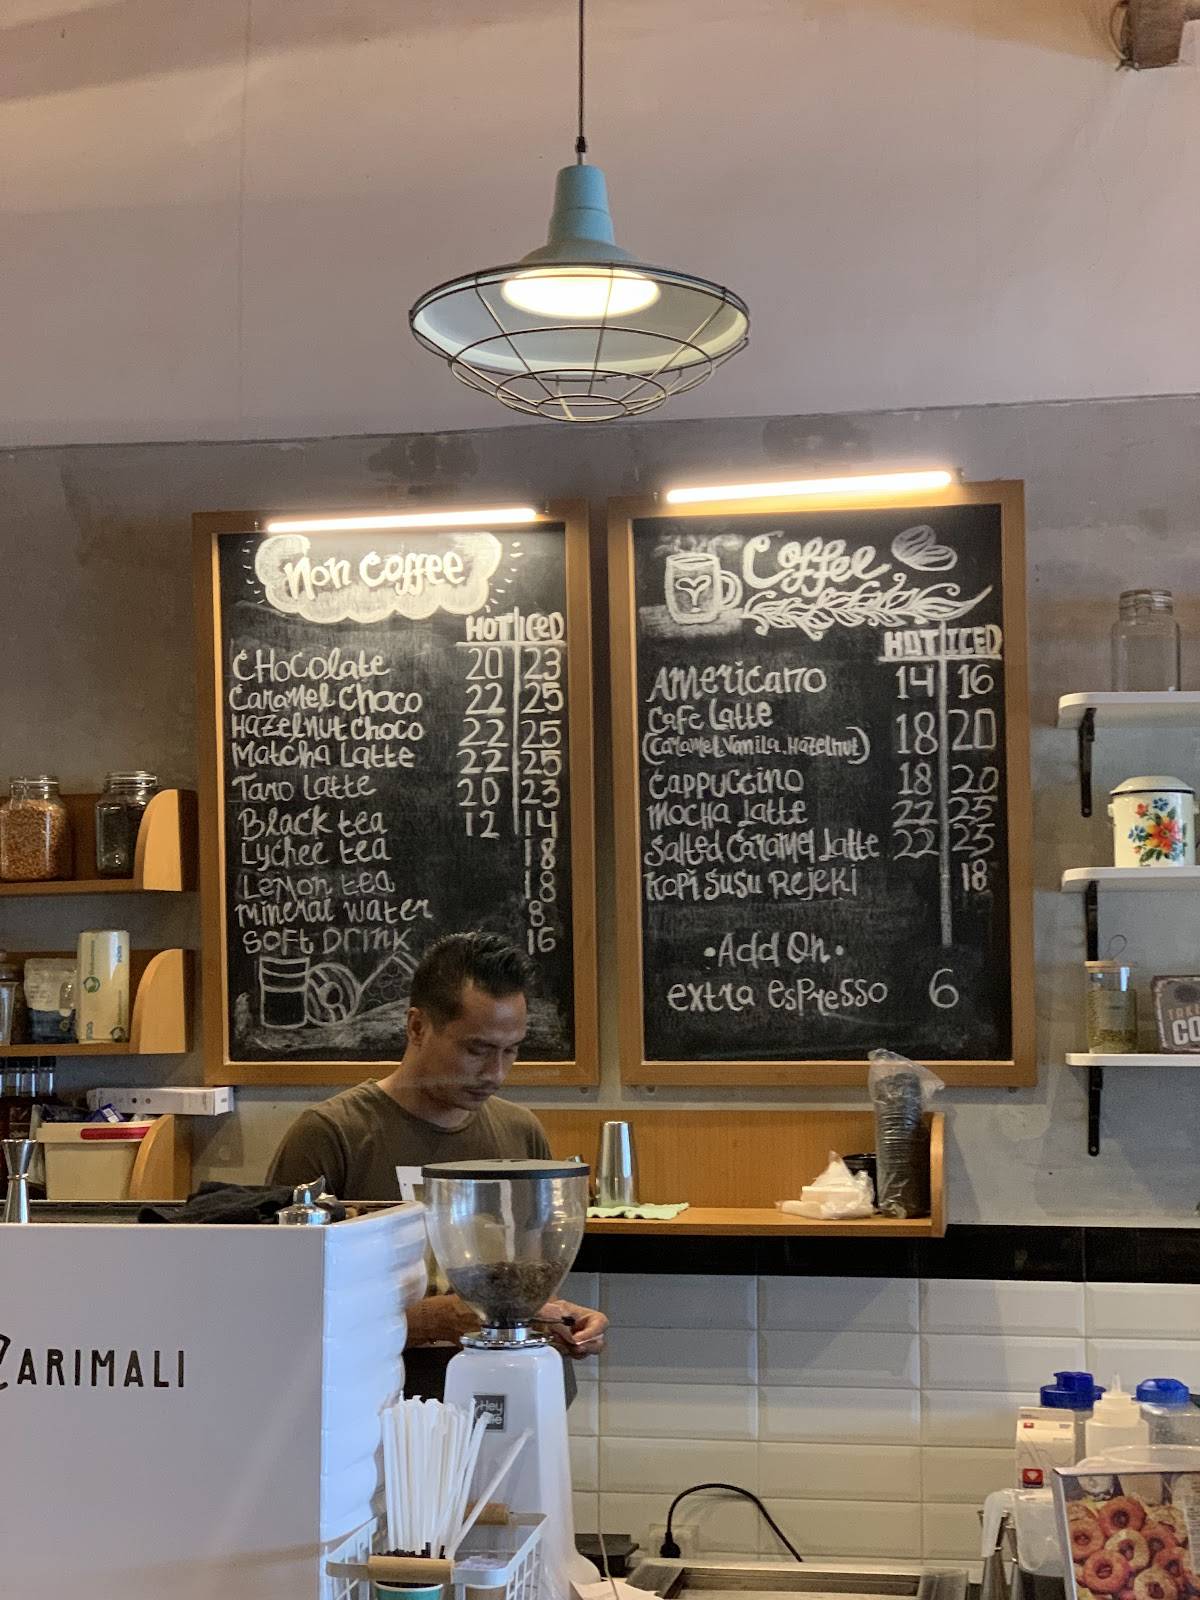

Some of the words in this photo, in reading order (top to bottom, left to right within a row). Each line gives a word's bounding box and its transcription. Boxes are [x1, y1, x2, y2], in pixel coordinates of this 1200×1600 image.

[359, 551, 466, 596] Coffee
[743, 531, 892, 597] Coffee
[465, 613, 514, 642] HOT
[884, 629, 938, 657] HOT
[945, 624, 1002, 655] ICED
[465, 647, 504, 680] 20
[523, 647, 562, 681] 23
[338, 683, 423, 715] Choco
[465, 682, 506, 715] 22
[520, 682, 565, 714] 25
[896, 665, 934, 699] 14
[957, 664, 995, 699] 16
[458, 718, 510, 747] 22
[520, 719, 562, 748] 25
[708, 698, 774, 731] Latte
[896, 711, 938, 755] 18
[948, 708, 996, 751] 20
[340, 742, 415, 770] Latte
[456, 749, 510, 774] 22
[520, 750, 562, 777] 25
[303, 774, 377, 801] Latte
[457, 777, 501, 807] 20
[521, 779, 561, 808] 23
[897, 762, 932, 796] 18
[951, 764, 999, 794] 20
[238, 804, 334, 842] Black
[338, 809, 388, 838] tea
[465, 810, 501, 839] 12
[525, 809, 558, 838] 14
[891, 800, 939, 828] 22
[949, 796, 998, 826] 25
[240, 836, 331, 872] Lychee
[339, 837, 392, 865] tea
[524, 837, 557, 870] 18
[893, 828, 940, 861] 22
[951, 822, 996, 859] 25
[341, 870, 396, 896] tea
[524, 870, 557, 903] 18
[961, 858, 988, 892] 18
[528, 899, 546, 927] 8
[526, 926, 557, 956] 16
[666, 979, 756, 1012] extra
[928, 968, 960, 1008] 6
[479, 1399, 503, 1416] Hey
